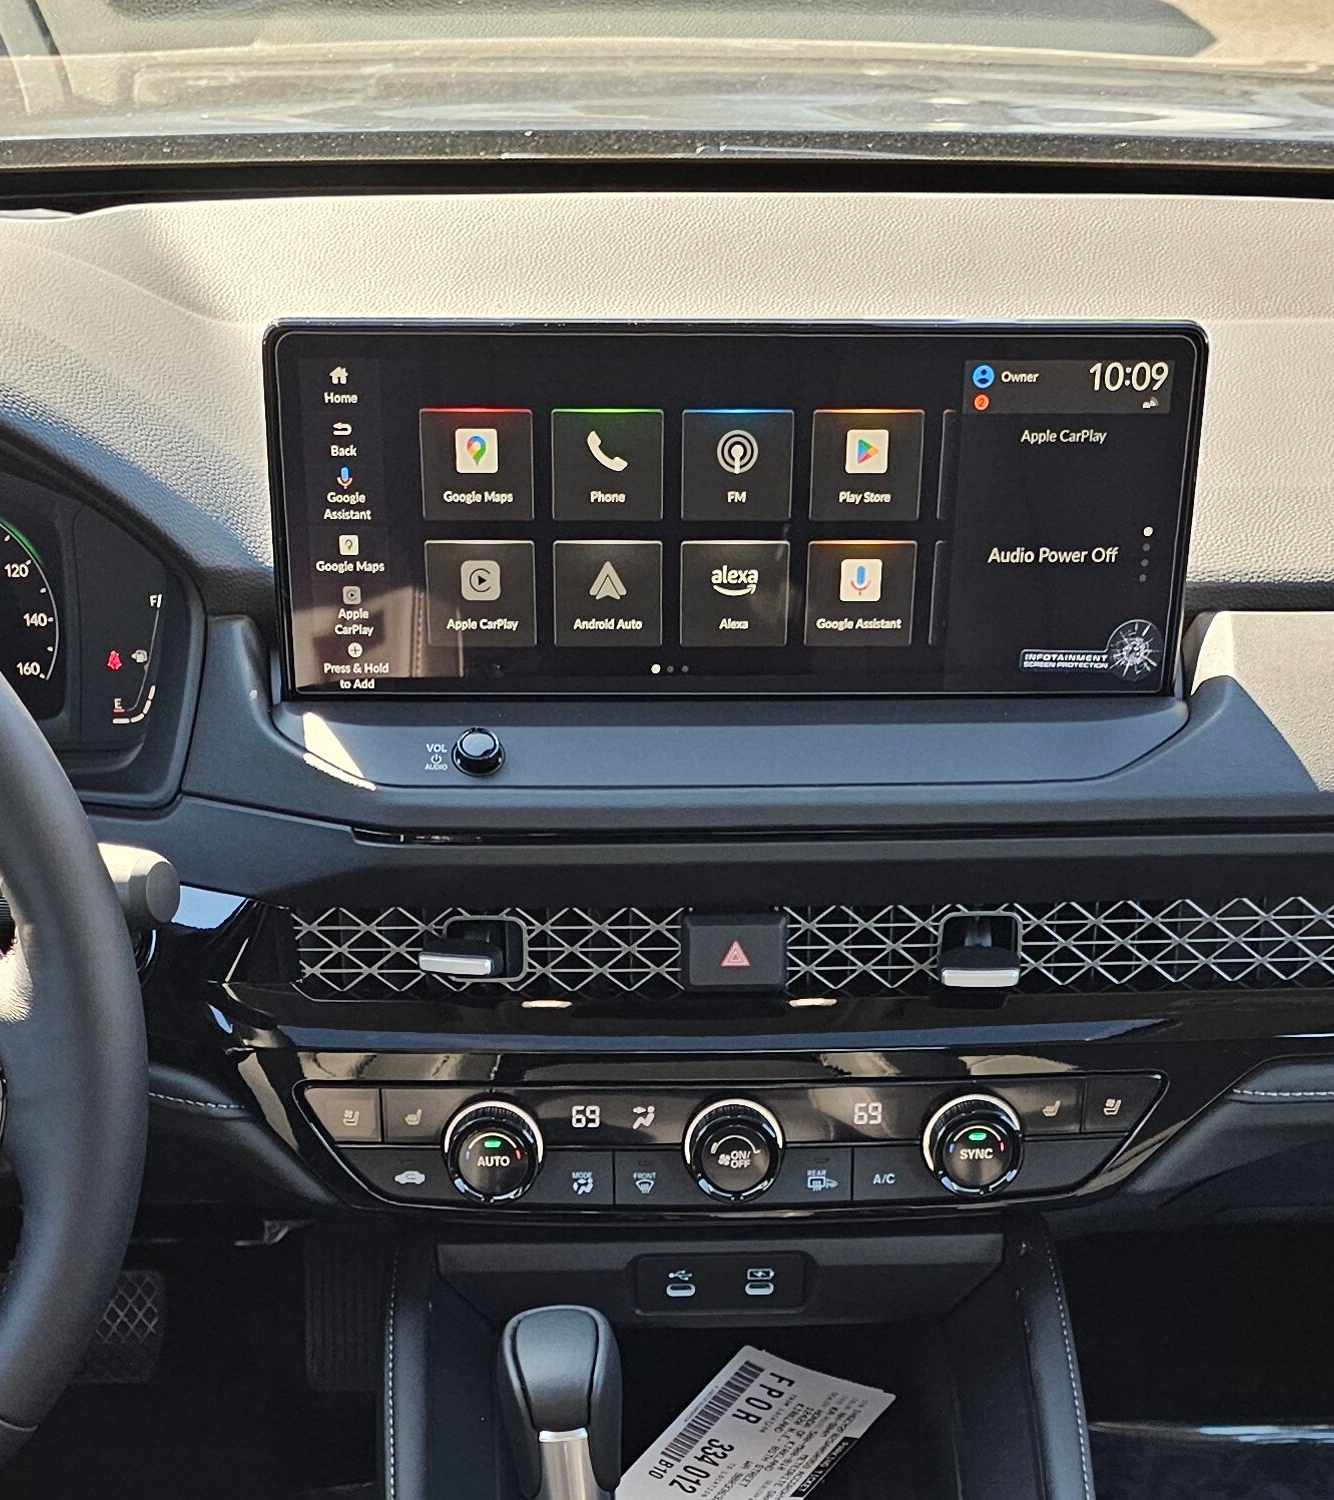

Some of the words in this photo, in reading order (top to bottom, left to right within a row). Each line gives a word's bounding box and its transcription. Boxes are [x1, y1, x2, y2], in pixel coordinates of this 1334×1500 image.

[1001, 371, 1039, 382] Owner
[1090, 362, 1168, 391] 10:09
[324, 392, 358, 403] Home
[1021, 430, 1057, 444] Apple
[1060, 430, 1107, 444] CarPlay
[331, 445, 357, 456] Back
[327, 492, 366, 504] Google
[443, 491, 481, 505] Google
[484, 491, 513, 505] Maps
[590, 491, 625, 503] Phone
[728, 492, 746, 502] FM
[839, 492, 861, 504] Play
[864, 492, 891, 502] Store
[324, 509, 371, 520] Assistant
[988, 548, 1034, 563] Audio
[1039, 548, 1088, 563] Power
[1092, 547, 1119, 563] Off
[5, 564, 28, 578] 120
[316, 561, 353, 573] Google
[356, 561, 385, 573] Maps
[711, 565, 758, 584] alexa
[150, 595, 157, 608] F
[23, 613, 47, 627] 140
[338, 609, 368, 620] Apple
[447, 619, 477, 630] Apple
[479, 619, 518, 630] CarPlay
[574, 619, 614, 630] Android
[616, 619, 642, 630] Auto
[719, 619, 748, 629] Alexa
[817, 619, 853, 631] Google
[855, 619, 902, 629] Assistant
[335, 625, 374, 636] CarPlay
[16, 662, 40, 676] 160
[324, 663, 350, 674] Press
[353, 663, 362, 674] &
[365, 663, 389, 673] Hold
[340, 680, 350, 689] to
[353, 679, 375, 689] Add
[114, 698, 122, 710] E
[426, 744, 447, 752] VOL
[571, 1105, 600, 1128] 69
[853, 1103, 883, 1125] 69
[730, 1150, 751, 1160] ON/
[960, 1148, 993, 1160] SYNC
[477, 1155, 510, 1168] AUTO
[730, 1159, 751, 1169] OFF
[872, 1172, 895, 1185] A/C
[694, 1438, 735, 1467] 334
[648, 1458, 674, 1480] B10
[668, 1465, 710, 1494] 012
